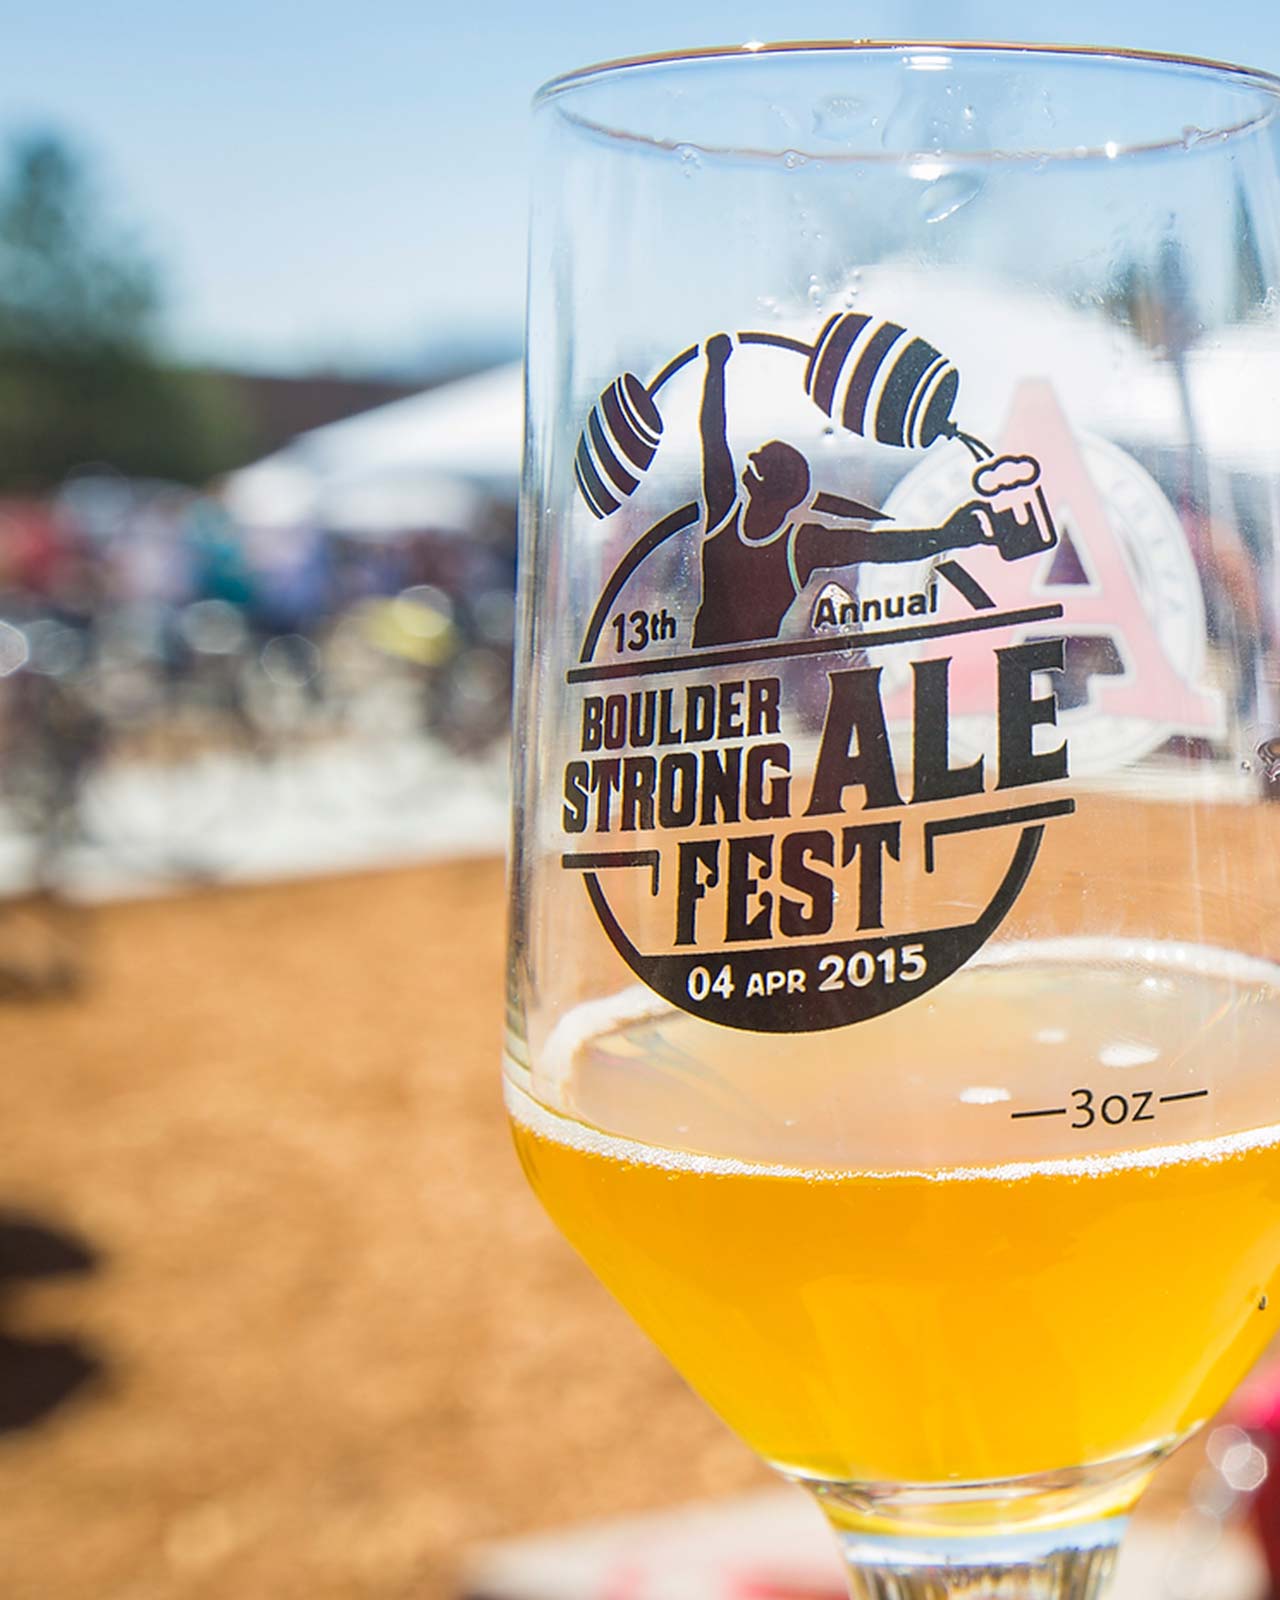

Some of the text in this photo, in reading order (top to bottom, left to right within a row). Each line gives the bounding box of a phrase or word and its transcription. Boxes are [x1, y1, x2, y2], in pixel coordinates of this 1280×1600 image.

[612, 584, 938, 653] 13th Annual
[582, 678, 781, 752] BOULDER
[802, 638, 1069, 818] ALE
[563, 743, 793, 833] STRONG
[673, 821, 902, 947] FEST
[687, 944, 929, 1001] 04 APR 2015
